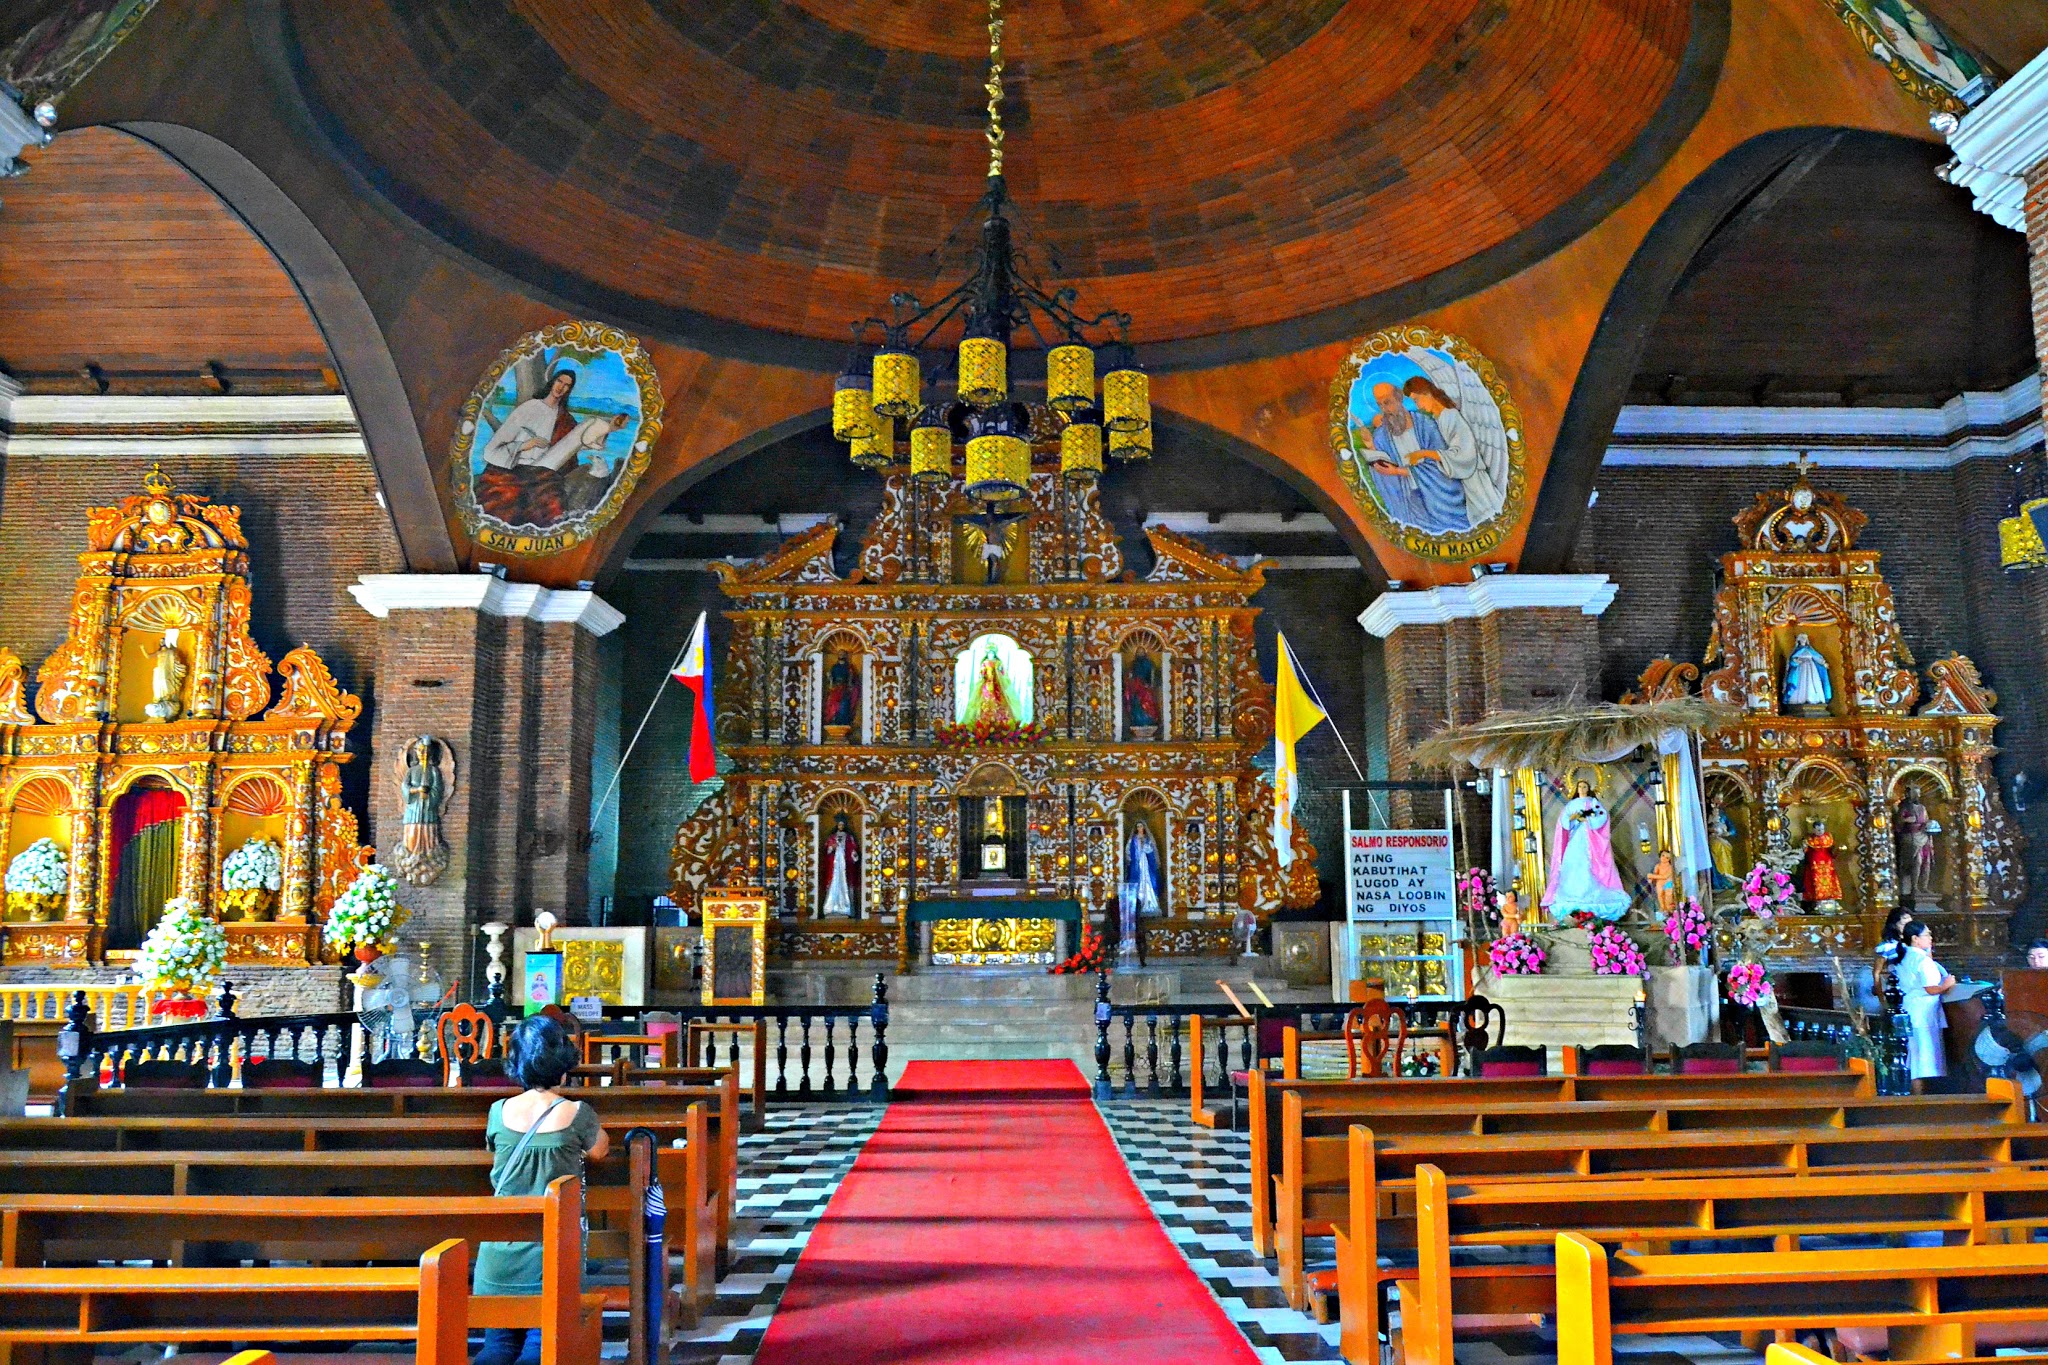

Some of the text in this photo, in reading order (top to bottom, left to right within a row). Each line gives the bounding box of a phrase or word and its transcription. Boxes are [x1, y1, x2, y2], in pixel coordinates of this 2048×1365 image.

[488, 533, 563, 551] SAN JUAN
[1413, 534, 1493, 556] SAN MATEO
[1352, 836, 1448, 848] SALMO RESPONSORIO
[1354, 854, 1393, 863] ATING
[1356, 879, 1424, 888] LUGOD AY
[1357, 891, 1446, 900] NASA LOOBIN
[1357, 903, 1426, 913] NG DIYOS
